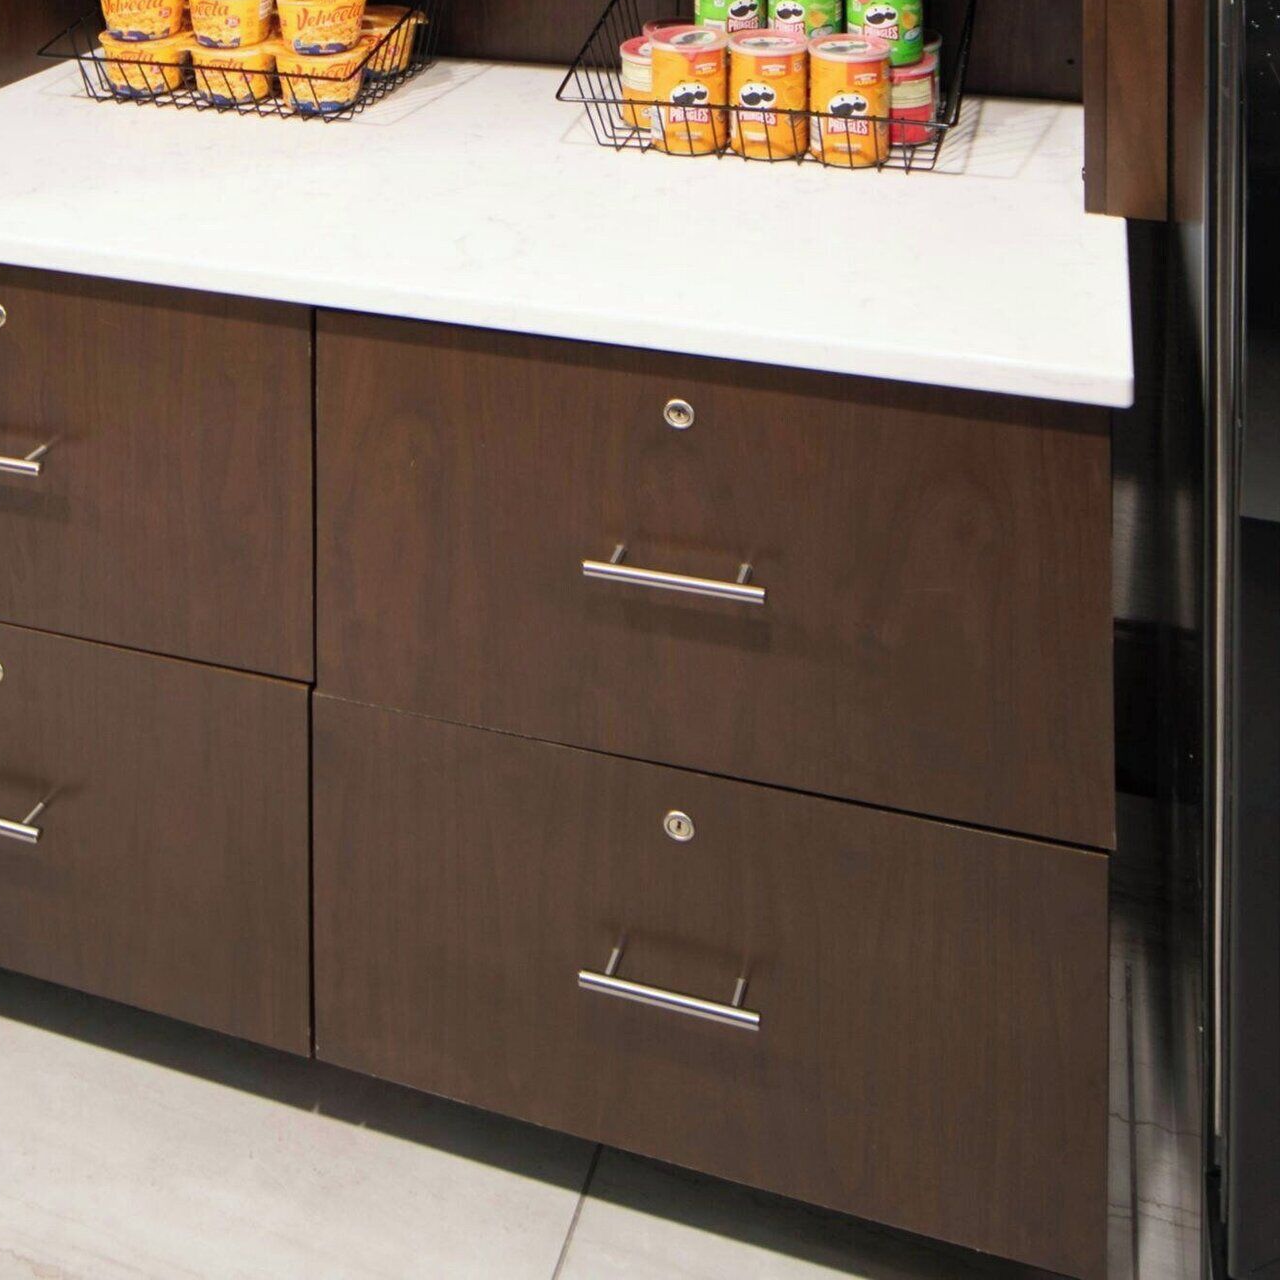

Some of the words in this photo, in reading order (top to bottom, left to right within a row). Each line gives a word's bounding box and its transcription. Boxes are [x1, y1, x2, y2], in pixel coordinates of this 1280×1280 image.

[297, 2, 362, 30] Velveeta
[728, 20, 759, 32] PRINGLES
[775, 22, 805, 33] PRINGLES
[865, 26, 898, 39] PRINGLES
[671, 108, 708, 122] PRINGLES
[828, 120, 868, 133] PRINGLES
